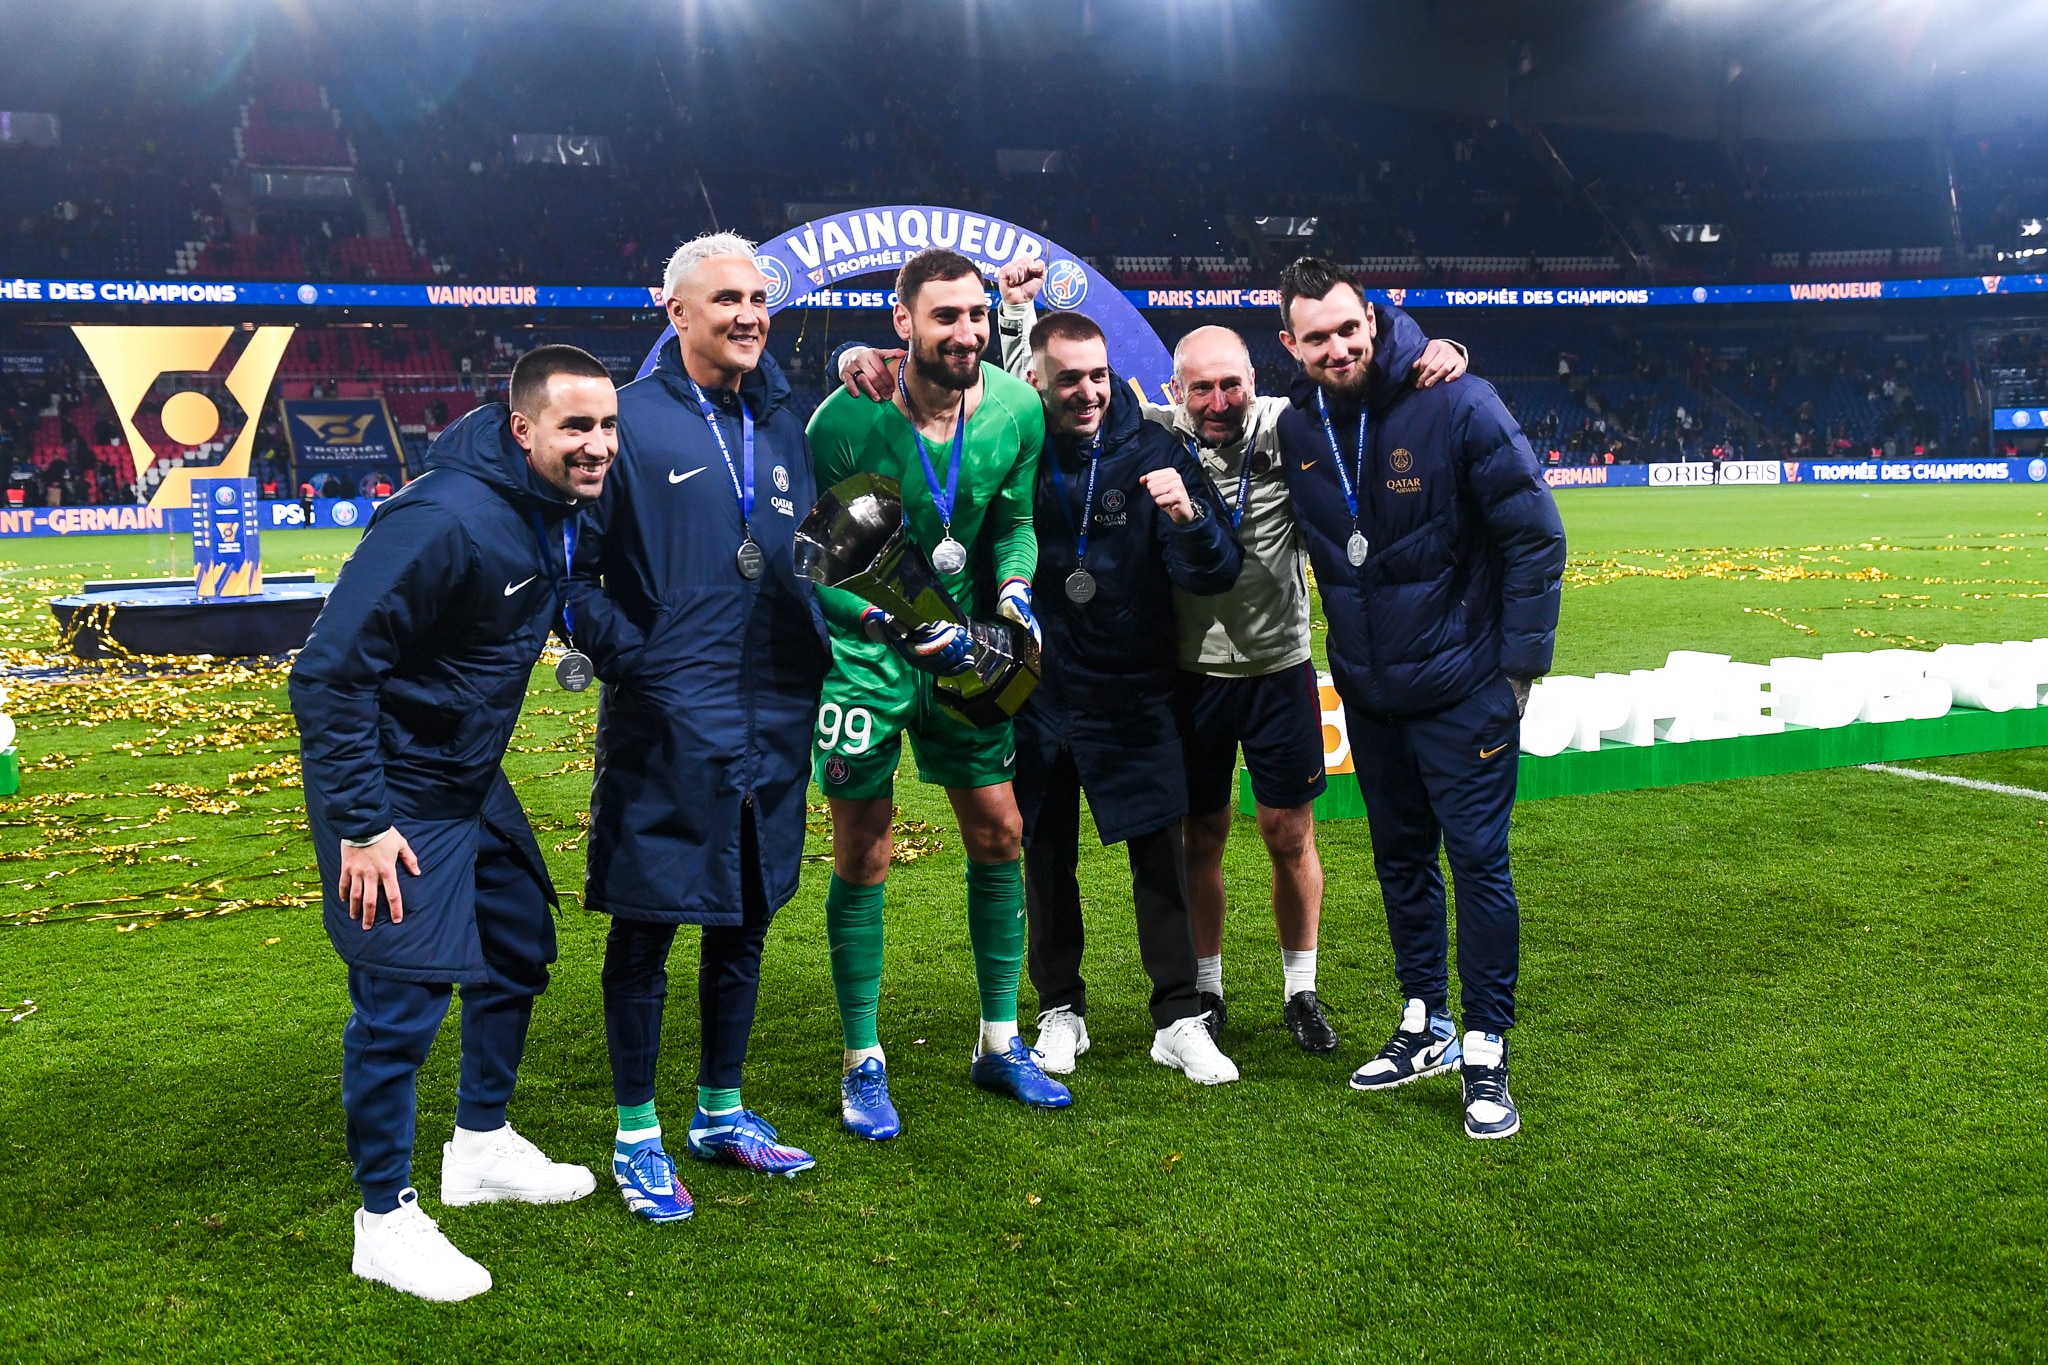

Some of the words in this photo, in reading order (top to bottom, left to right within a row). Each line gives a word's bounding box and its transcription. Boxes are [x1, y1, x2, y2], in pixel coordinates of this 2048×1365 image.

[786, 209, 1043, 269] VAINQUEUR
[827, 248, 903, 278] TROPHÉE
[1060, 261, 1085, 285] PARIS
[49, 282, 96, 300] DES
[100, 283, 237, 302] CHAMPIONS
[426, 285, 537, 306] VAINQUEUR
[848, 292, 884, 307] DES
[1148, 290, 1194, 307] PARIS
[1195, 289, 1281, 306] SAINT-GER
[1446, 288, 1518, 305] TROPHÉE
[1523, 290, 1553, 304] DES
[1556, 290, 1648, 304] CHAMPIONS
[1790, 281, 1882, 300] VAINQUEUR
[1543, 467, 1607, 486] GERMAIN
[1654, 465, 1714, 482] ORIS
[1724, 464, 1778, 481] ORIS
[1812, 461, 1878, 480] TROPHÉE
[1881, 464, 1912, 480] DES
[1912, 462, 2009, 480] CHAMPIONS
[1386, 477, 1420, 490] QATAR
[771, 496, 793, 511] QATAR
[1094, 511, 1127, 522] QATAR
[817, 702, 872, 754] 99
